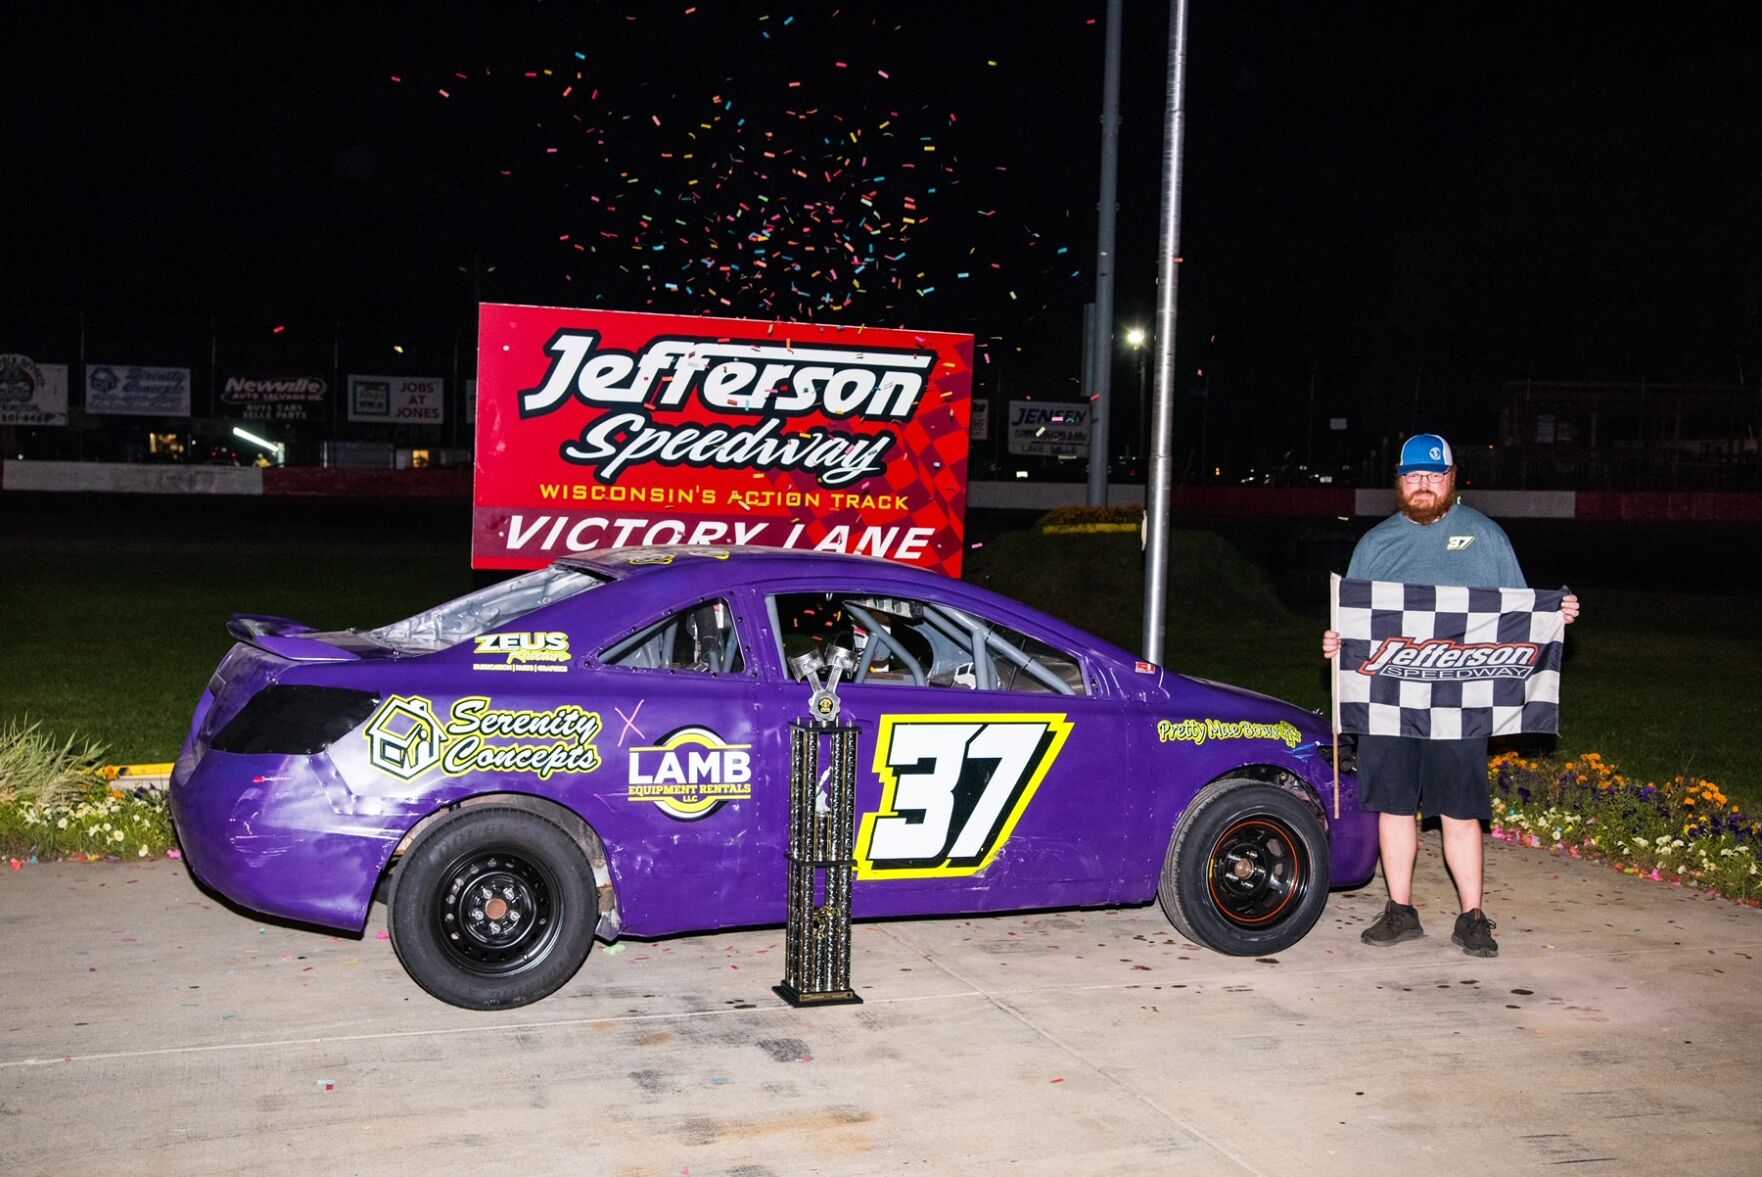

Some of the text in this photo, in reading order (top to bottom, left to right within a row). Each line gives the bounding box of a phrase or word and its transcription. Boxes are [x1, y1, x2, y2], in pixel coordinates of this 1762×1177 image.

[225, 377, 321, 393] Newville
[400, 382, 435, 393] JOBS
[523, 332, 935, 418] Jefferson
[395, 407, 440, 419] JONES
[408, 395, 426, 405] AT
[1011, 408, 1087, 426] JENSEN
[565, 416, 893, 484] Speedway
[539, 484, 909, 511] WISCONSIN'S ACTION TRACK
[505, 514, 769, 550] VICTORY
[1447, 536, 1474, 550] 37
[474, 632, 569, 653] ZEUS
[1367, 641, 1536, 671] Jefferson
[1386, 666, 1528, 680] SPEEDWAY
[447, 697, 601, 743] Serenity
[1158, 720, 1206, 745] Pretty
[1206, 719, 1241, 739] Mae
[442, 738, 600, 779] Concepts
[628, 751, 752, 784] LAMB
[628, 783, 751, 796] EQUIPMENT RENTALS
[866, 721, 1051, 861] 37
